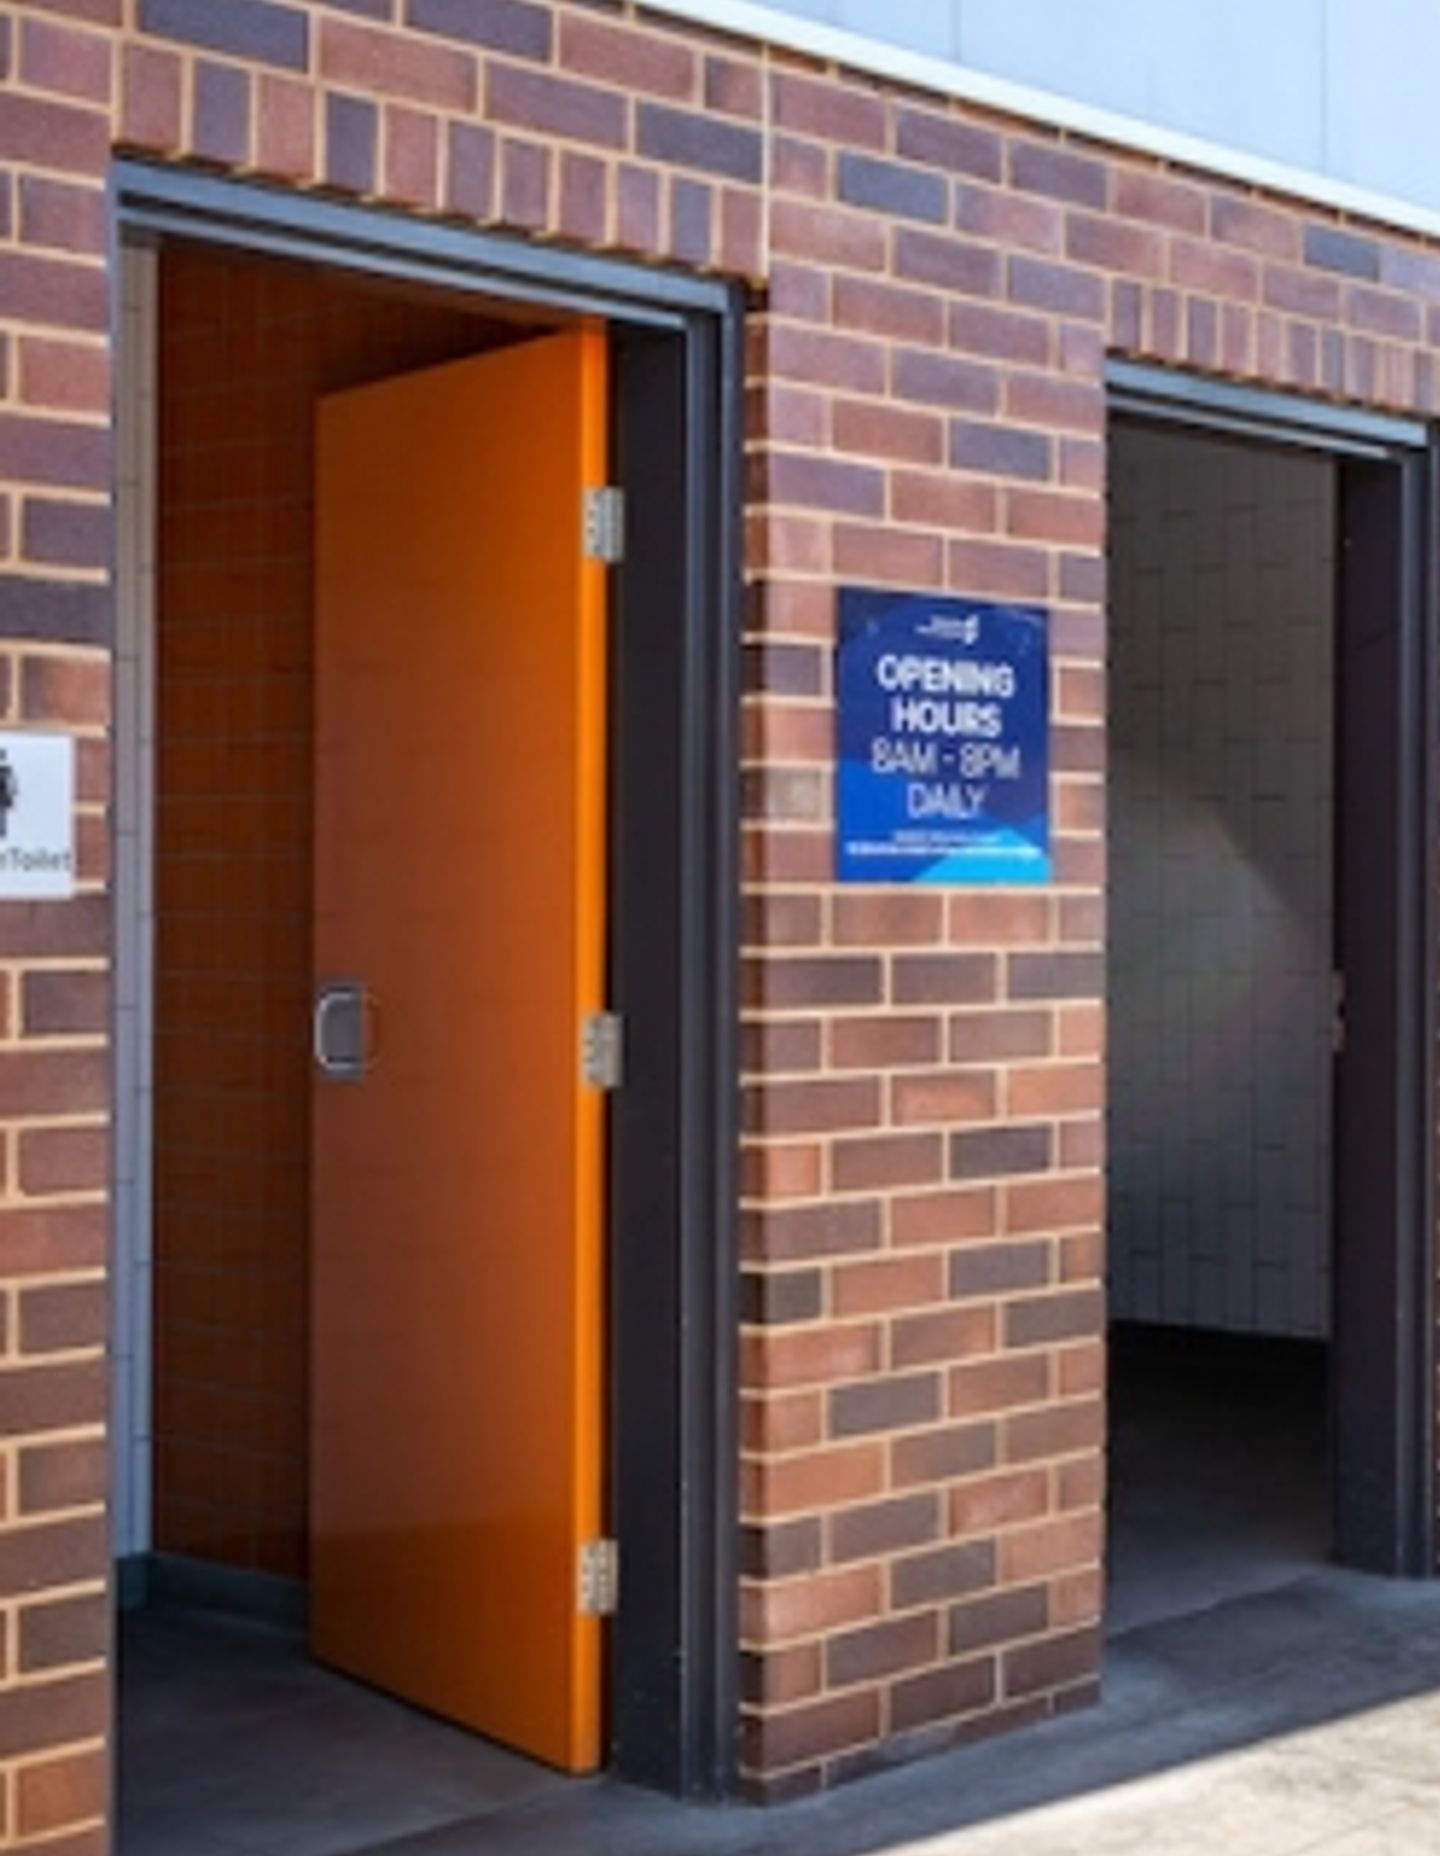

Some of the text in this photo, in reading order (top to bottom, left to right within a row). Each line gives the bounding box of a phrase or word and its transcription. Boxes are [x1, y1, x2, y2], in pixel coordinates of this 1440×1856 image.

[876, 653, 1016, 698] OPENING
[890, 698, 1002, 738] HOURS
[871, 737, 937, 773] 8AM
[959, 742, 1021, 778] 8PM
[906, 783, 989, 819] DAILY
